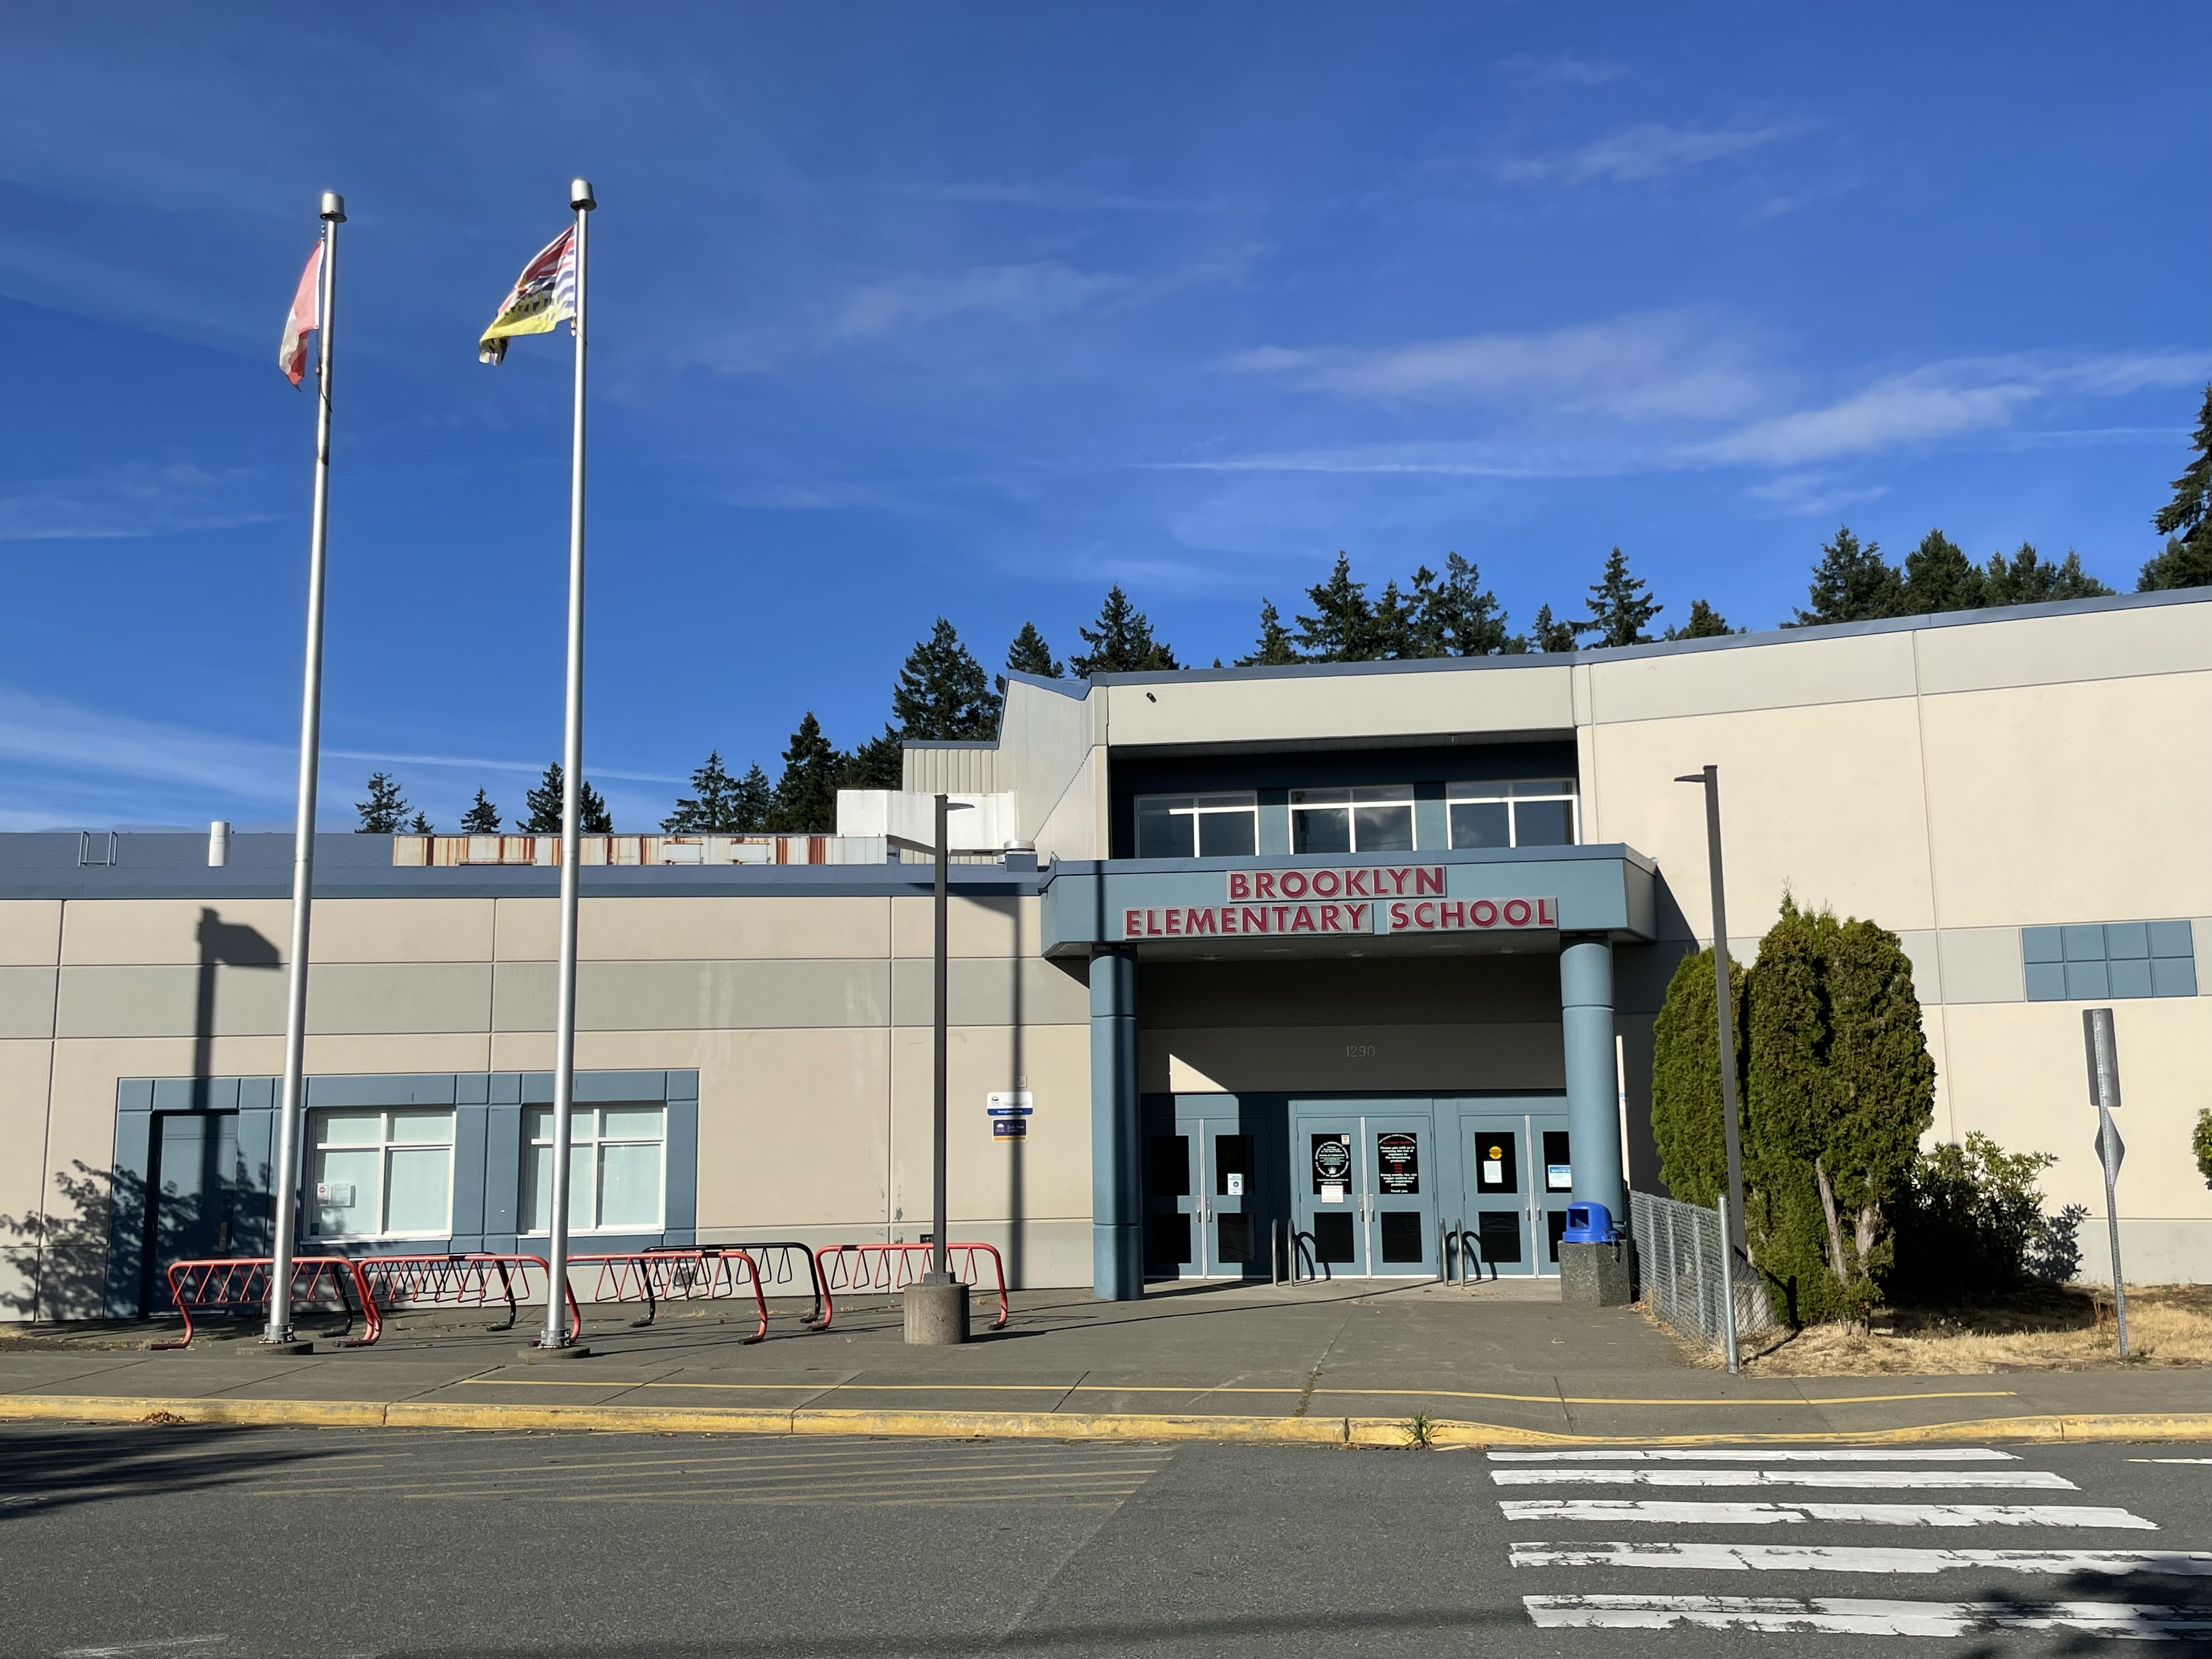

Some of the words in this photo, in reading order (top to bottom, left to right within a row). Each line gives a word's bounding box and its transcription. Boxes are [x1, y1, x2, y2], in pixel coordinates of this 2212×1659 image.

[1229, 868, 1443, 899] BROOKLYN
[1126, 904, 1367, 936] ELEMENTARY
[1390, 899, 1555, 929] SCHOOL
[1346, 1045, 1375, 1057] 1290
